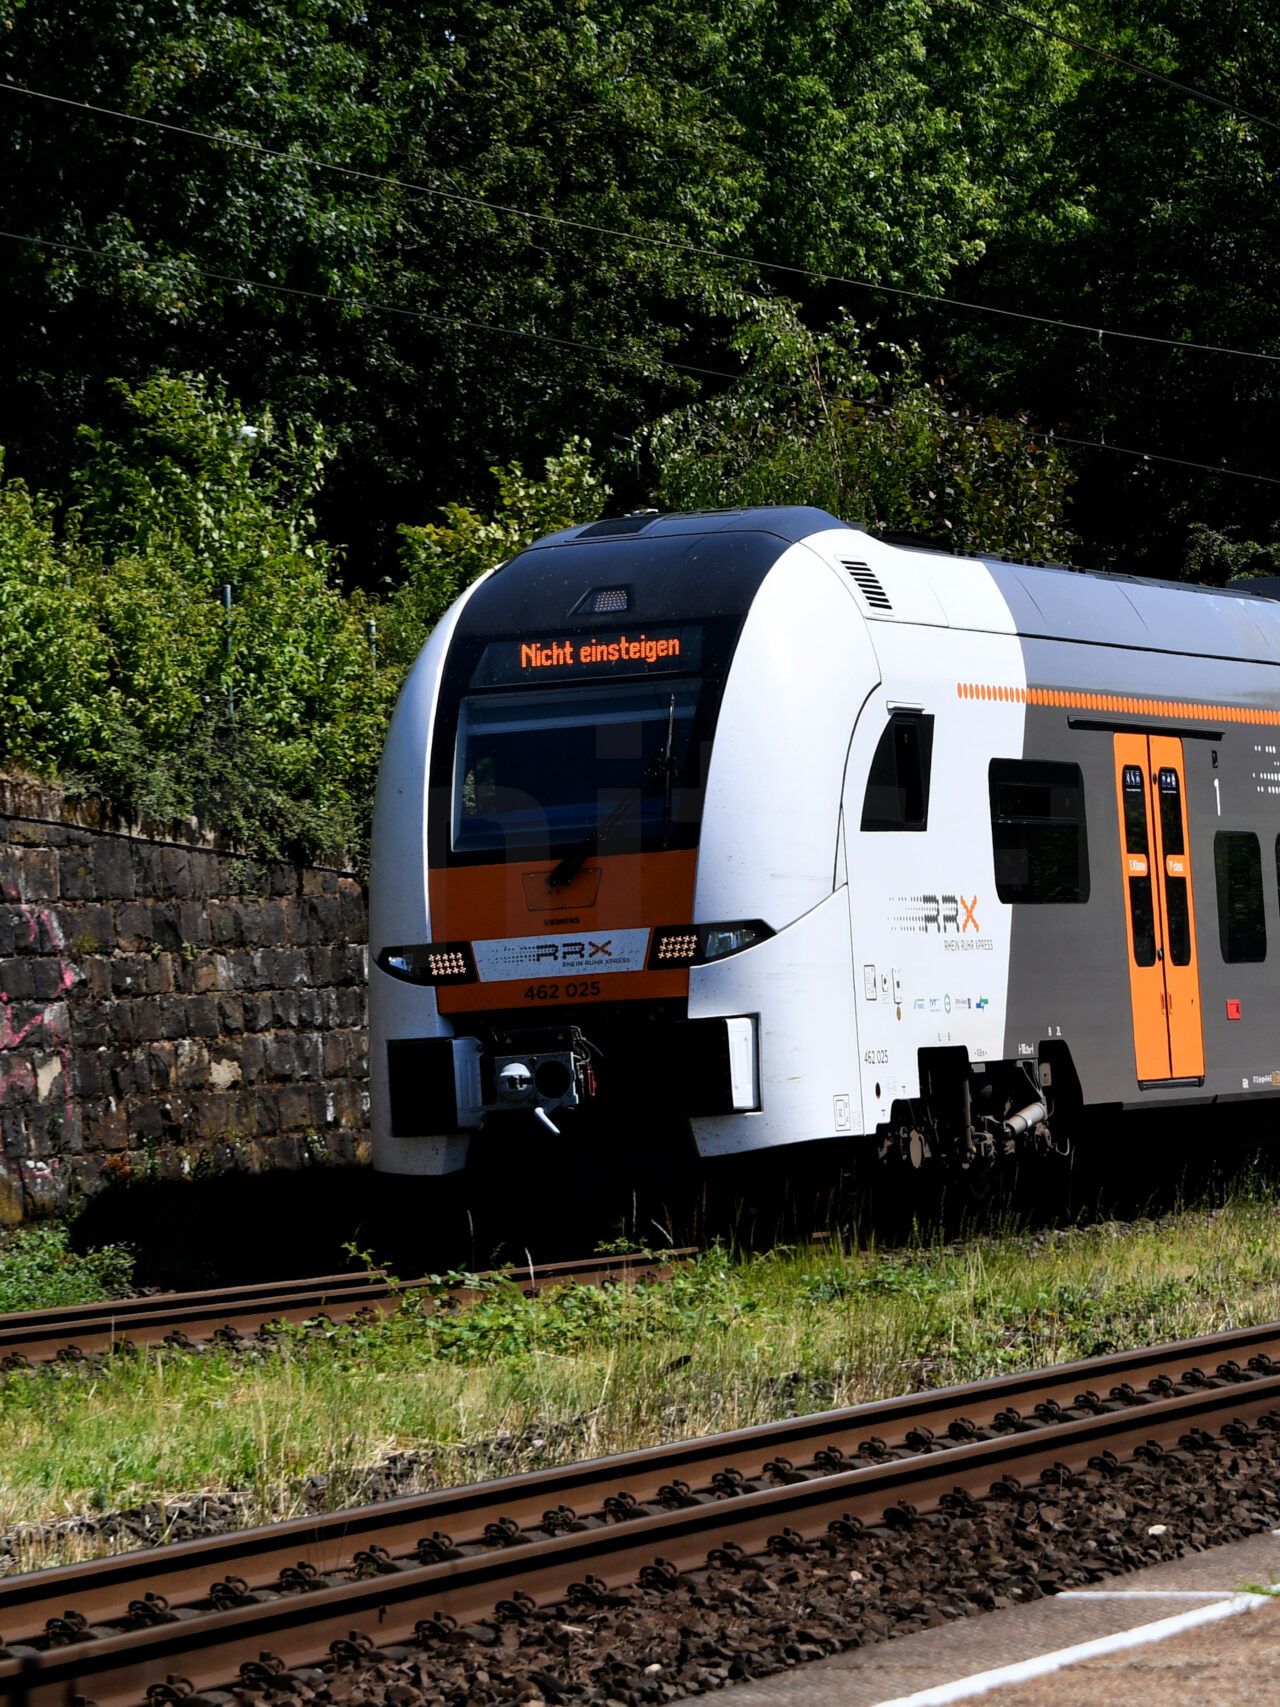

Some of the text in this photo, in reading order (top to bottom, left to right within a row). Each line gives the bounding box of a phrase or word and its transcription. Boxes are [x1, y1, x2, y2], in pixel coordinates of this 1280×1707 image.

[520, 634, 680, 668] Nicht einsteigen
[1213, 778, 1221, 816] 1
[543, 916, 581, 926] SIEMENS
[922, 894, 980, 934] RRX
[535, 939, 612, 963] RRX
[562, 957, 631, 968] RHEIN RUHR XPRESS
[524, 981, 601, 1001] 462 025
[864, 1049, 889, 1065] 462 025
